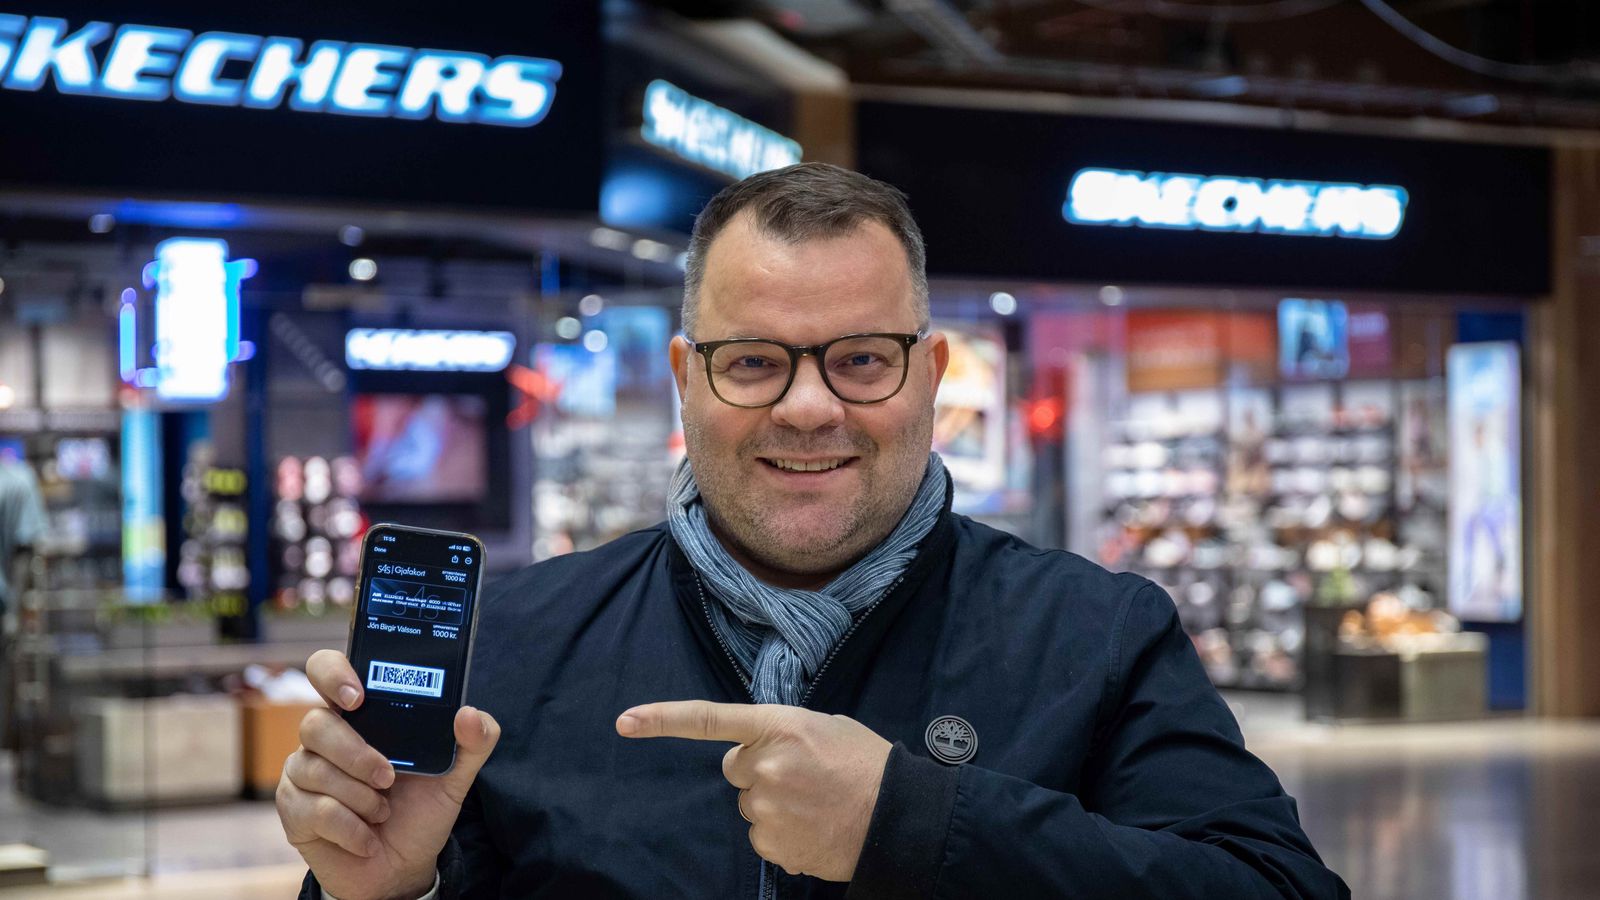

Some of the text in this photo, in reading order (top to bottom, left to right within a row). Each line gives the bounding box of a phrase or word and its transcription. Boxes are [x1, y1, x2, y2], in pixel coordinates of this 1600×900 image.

[394, 566, 426, 577] Gjafakort
[444, 574, 459, 582] 1000
[367, 621, 380, 629] Jón
[379, 622, 397, 633] Birgir
[432, 629, 457, 640] 1000 kr.
